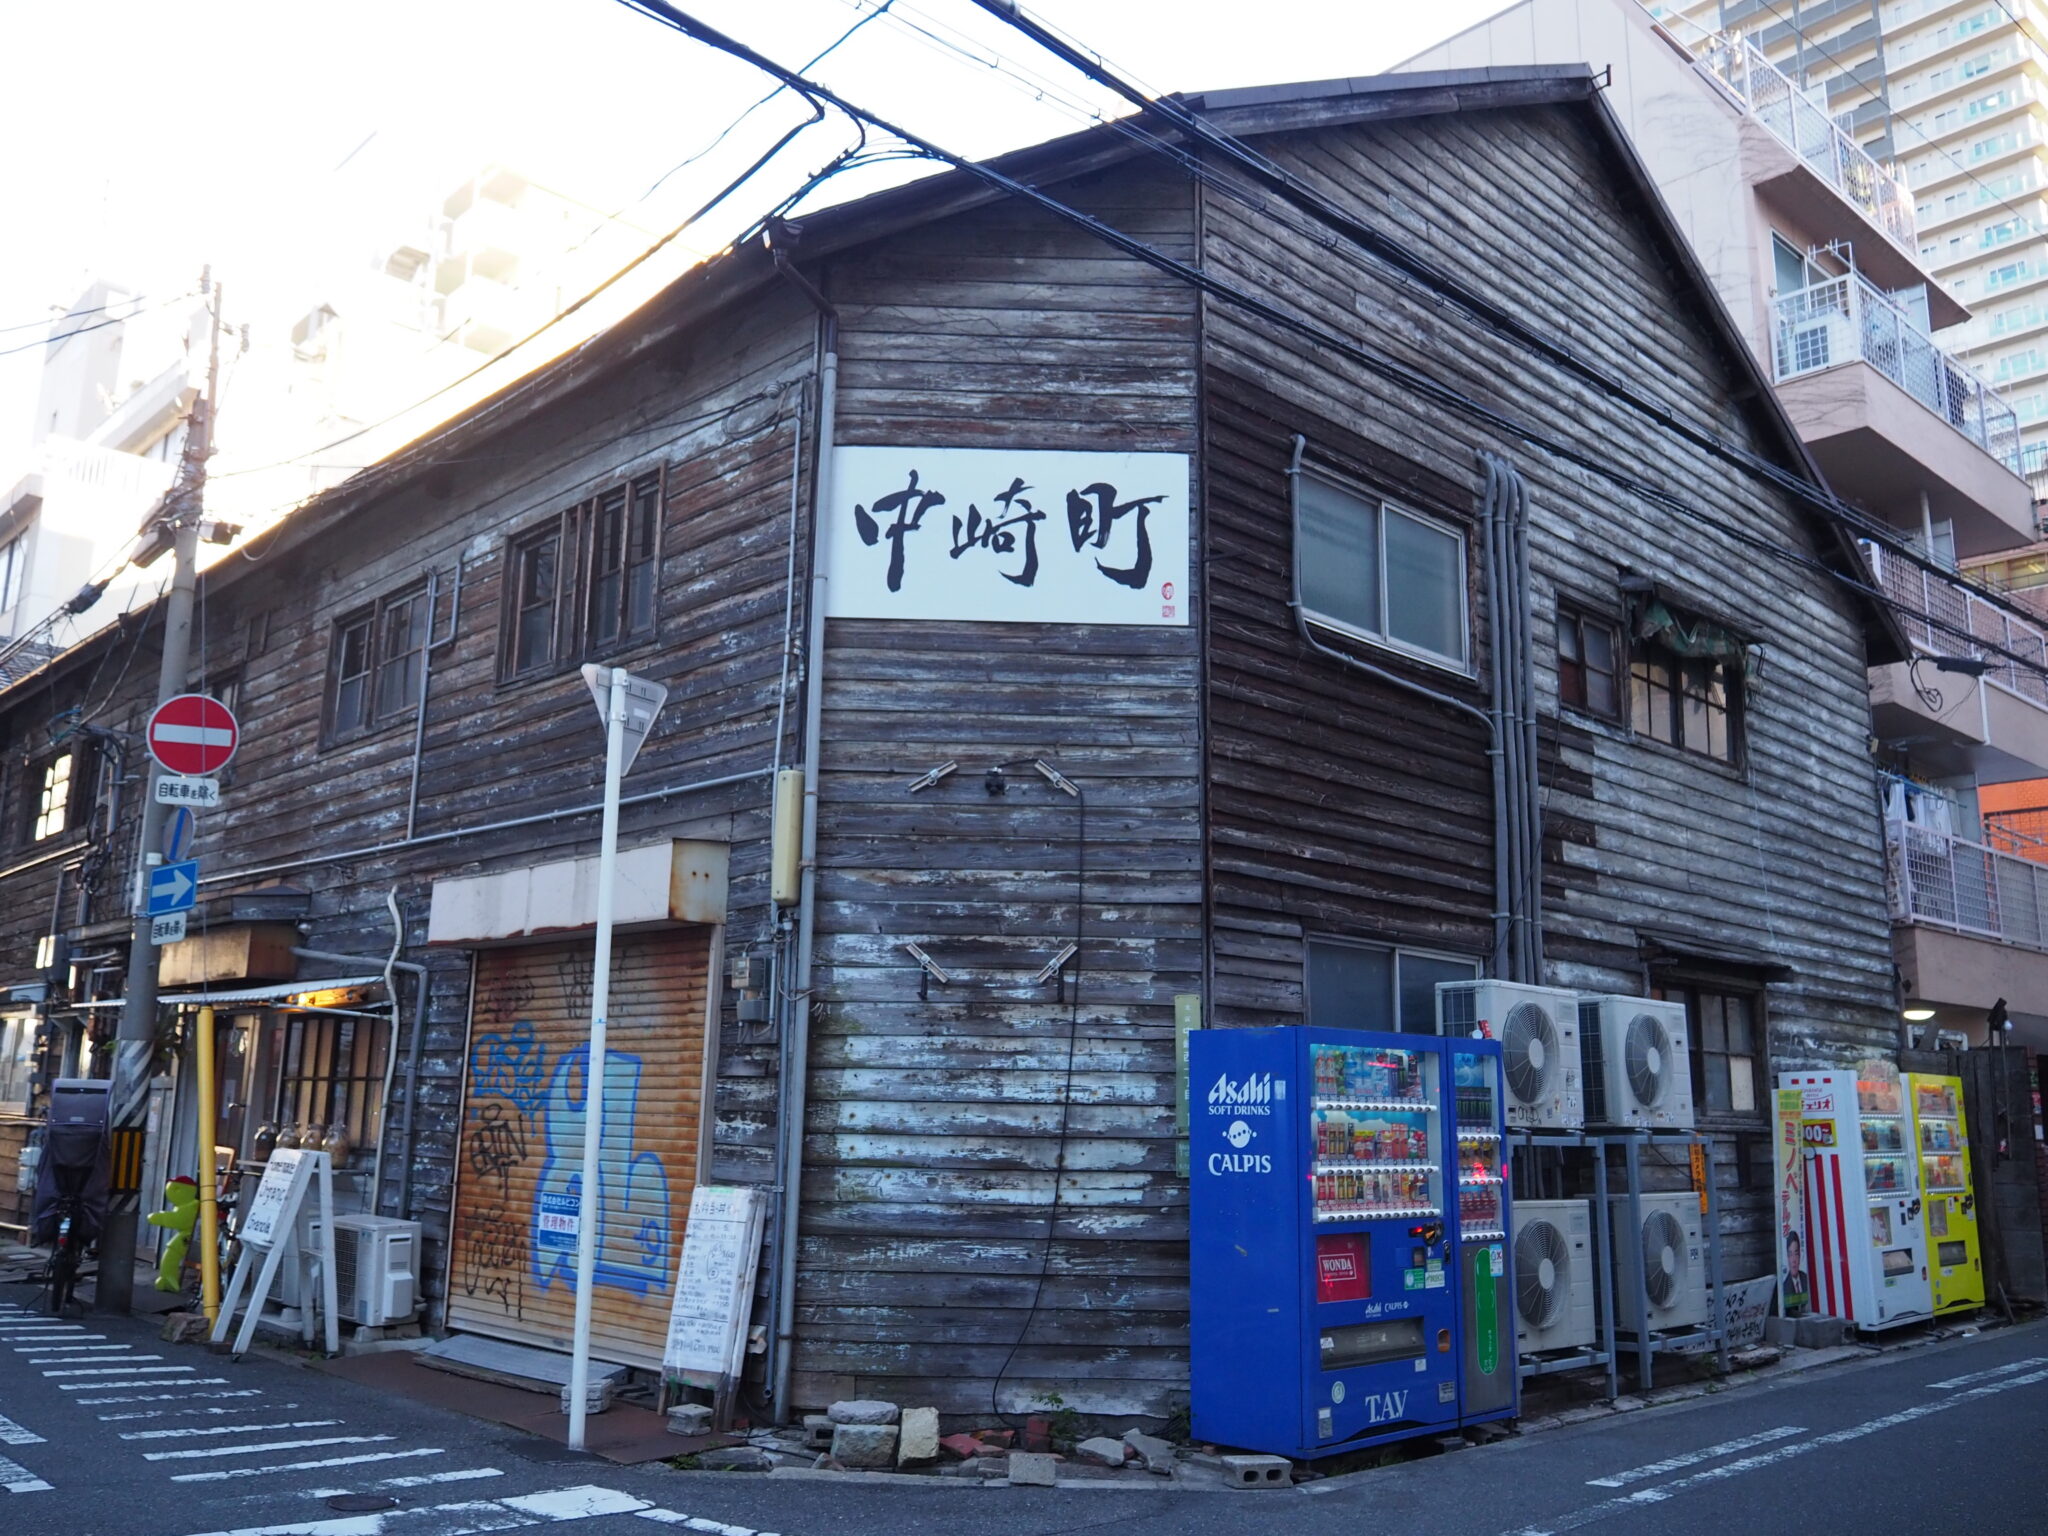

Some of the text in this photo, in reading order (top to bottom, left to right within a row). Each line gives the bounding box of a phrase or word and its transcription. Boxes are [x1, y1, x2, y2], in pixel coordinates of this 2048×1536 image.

[854, 469, 1170, 592] 中崎町
[158, 782, 216, 801] 自転車を除く
[1208, 1072, 1271, 1104] Asahi
[1208, 1105, 1271, 1116] SOFT DRINKS
[1208, 1153, 1272, 1176] CALPIS
[543, 1215, 574, 1232] 管理物件
[1322, 1258, 1353, 1272] WONDA
